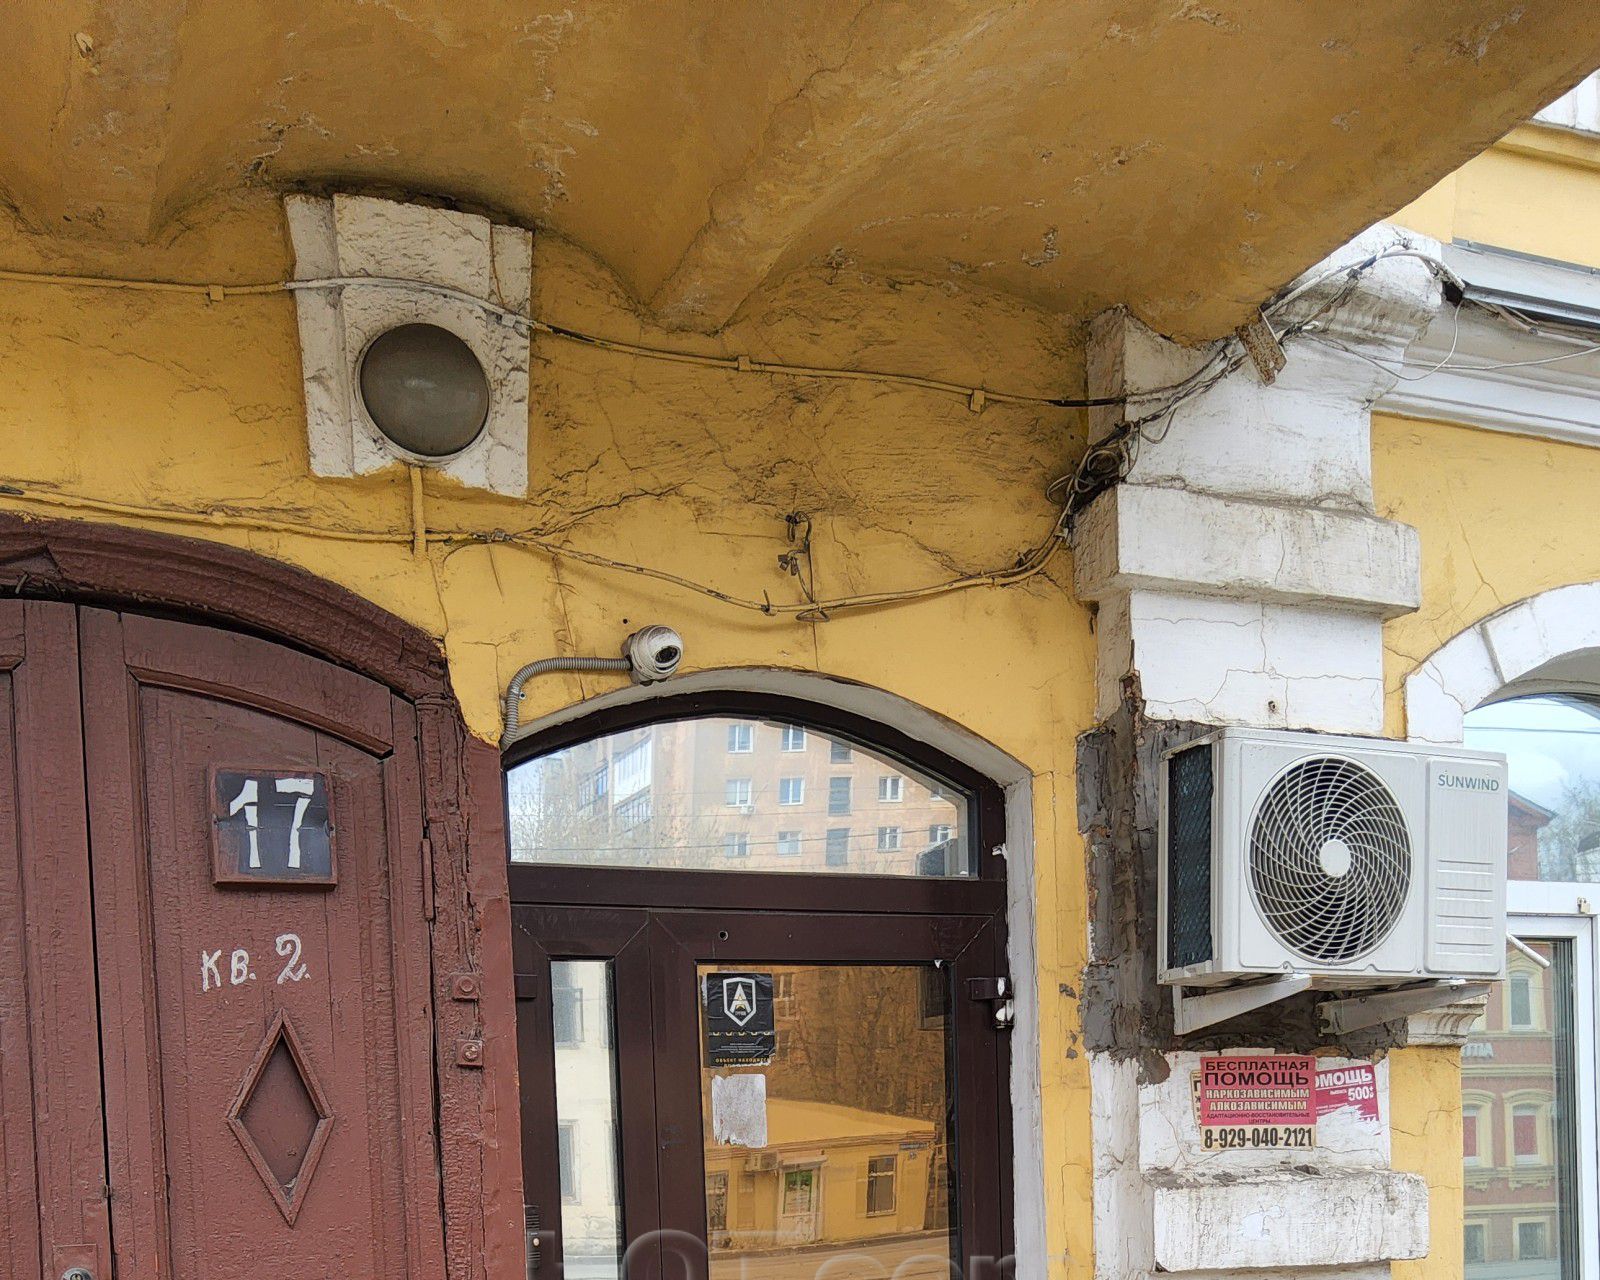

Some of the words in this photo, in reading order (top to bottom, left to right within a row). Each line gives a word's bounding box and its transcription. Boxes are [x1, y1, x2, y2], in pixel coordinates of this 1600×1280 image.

[1438, 774, 1499, 791] SUNWIND
[229, 778, 314, 868] 17
[1206, 1062, 1309, 1071] БЕСПЛАТНАЯ
[1204, 1072, 1309, 1088] ПОМОЩЬ
[1205, 1089, 1310, 1099] НАРКОЗАВИСИМЫМ
[1210, 1100, 1307, 1111] АЛКОЗАВИСИМЫМ
[1204, 1127, 1313, 1149] 8-929-040-2121
